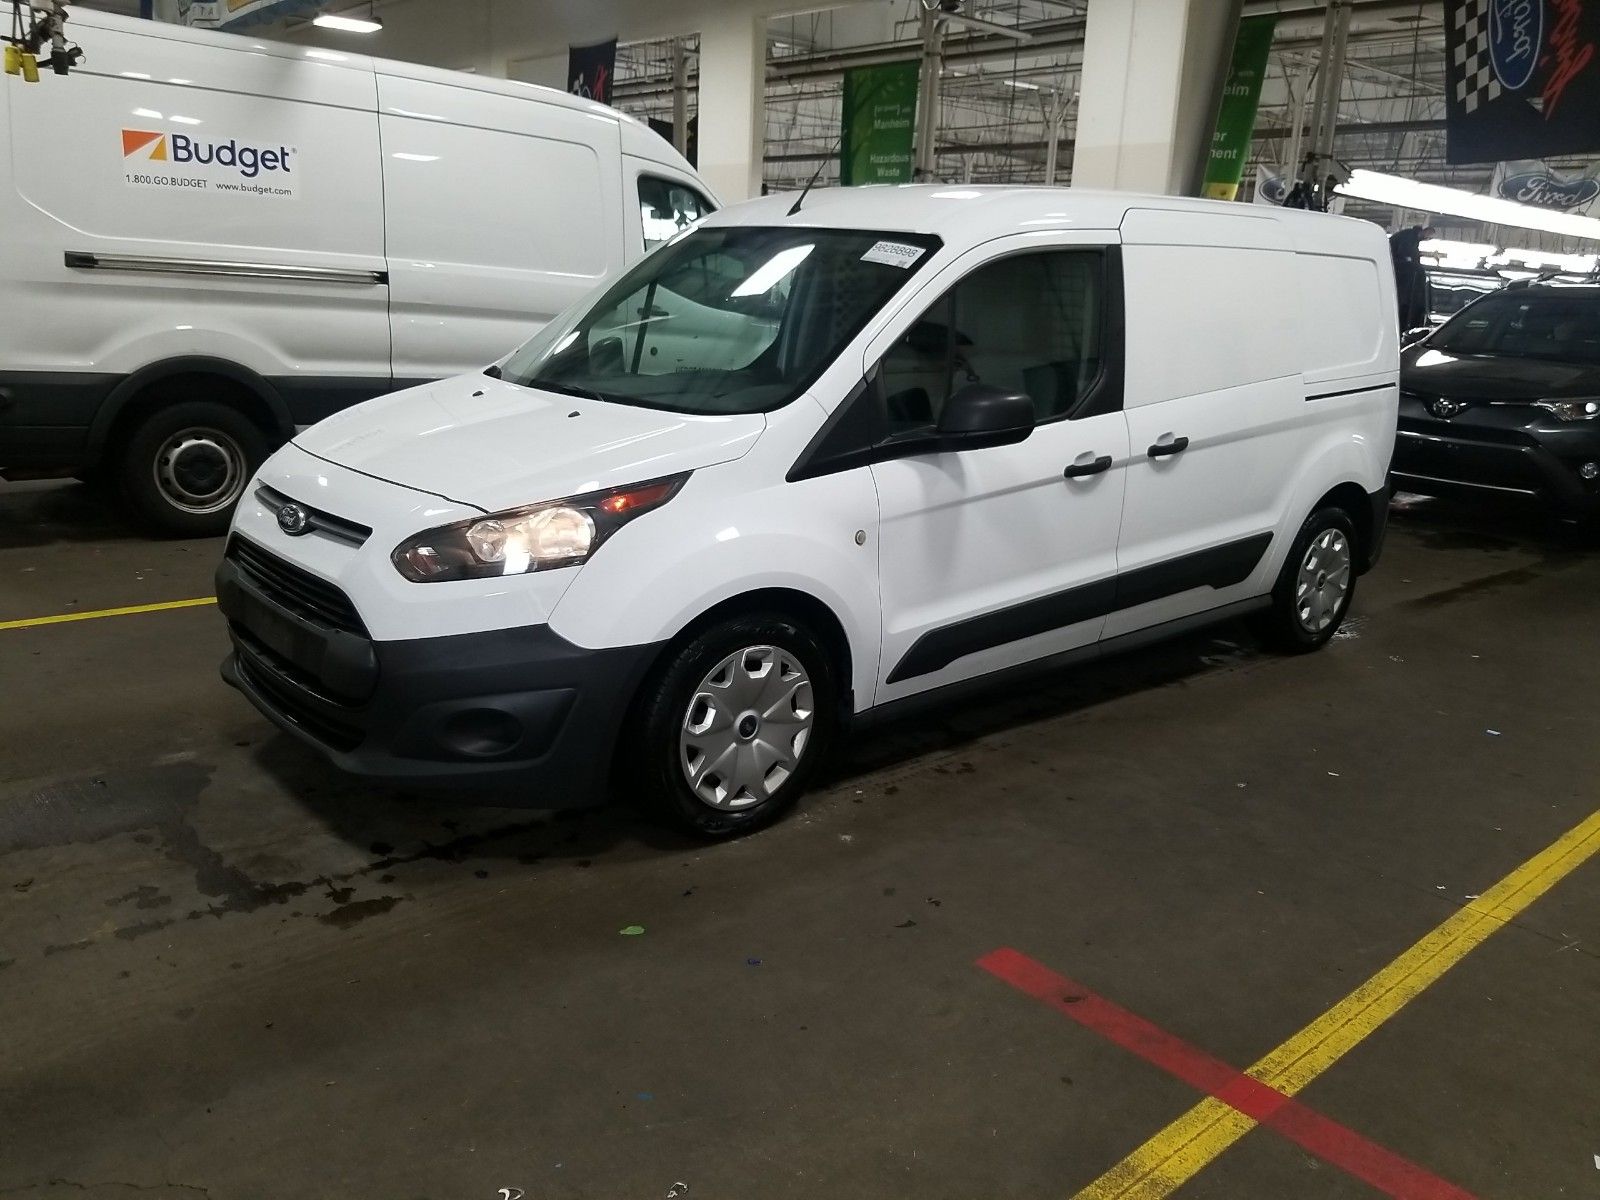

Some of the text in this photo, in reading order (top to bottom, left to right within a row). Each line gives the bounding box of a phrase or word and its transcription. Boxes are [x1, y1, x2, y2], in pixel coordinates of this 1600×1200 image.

[172, 133, 290, 178] Budget
[126, 174, 292, 196] 1.800.GO.BUDGET www.budget.com
